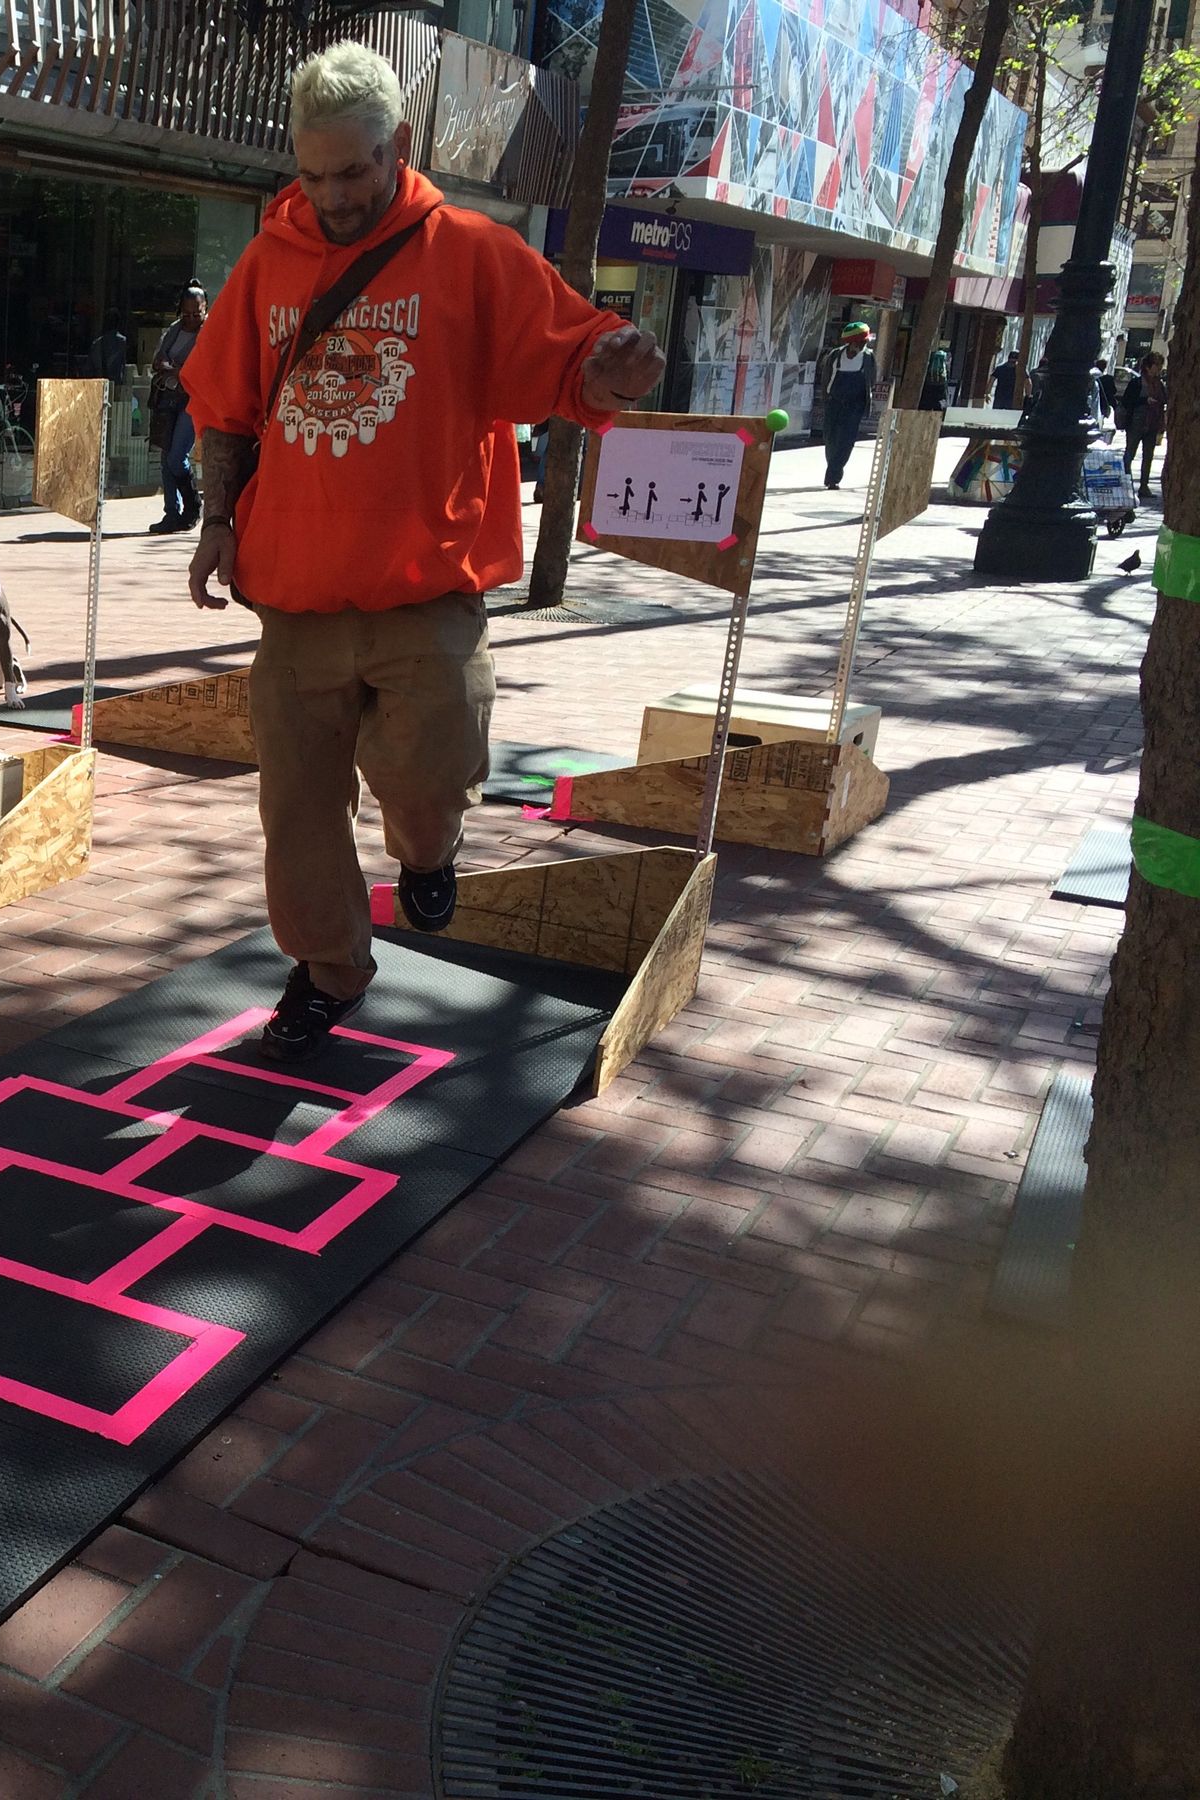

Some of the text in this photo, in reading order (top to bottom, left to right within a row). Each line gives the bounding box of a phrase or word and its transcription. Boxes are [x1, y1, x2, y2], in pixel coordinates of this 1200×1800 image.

[631, 219, 692, 250] metroPCS
[616, 295, 631, 303] LTE
[268, 304, 299, 346] SAN
[327, 337, 345, 352] 3X
[383, 346, 398, 358] 40
[394, 370, 402, 382] 7
[325, 379, 338, 388] 40
[332, 390, 356, 400] MVP
[381, 395, 396, 407] 12
[304, 401, 361, 417] BASEBALL
[285, 415, 296, 426] 54
[361, 416, 376, 428] 35
[307, 428, 314, 439] 8
[334, 429, 348, 441] 48
